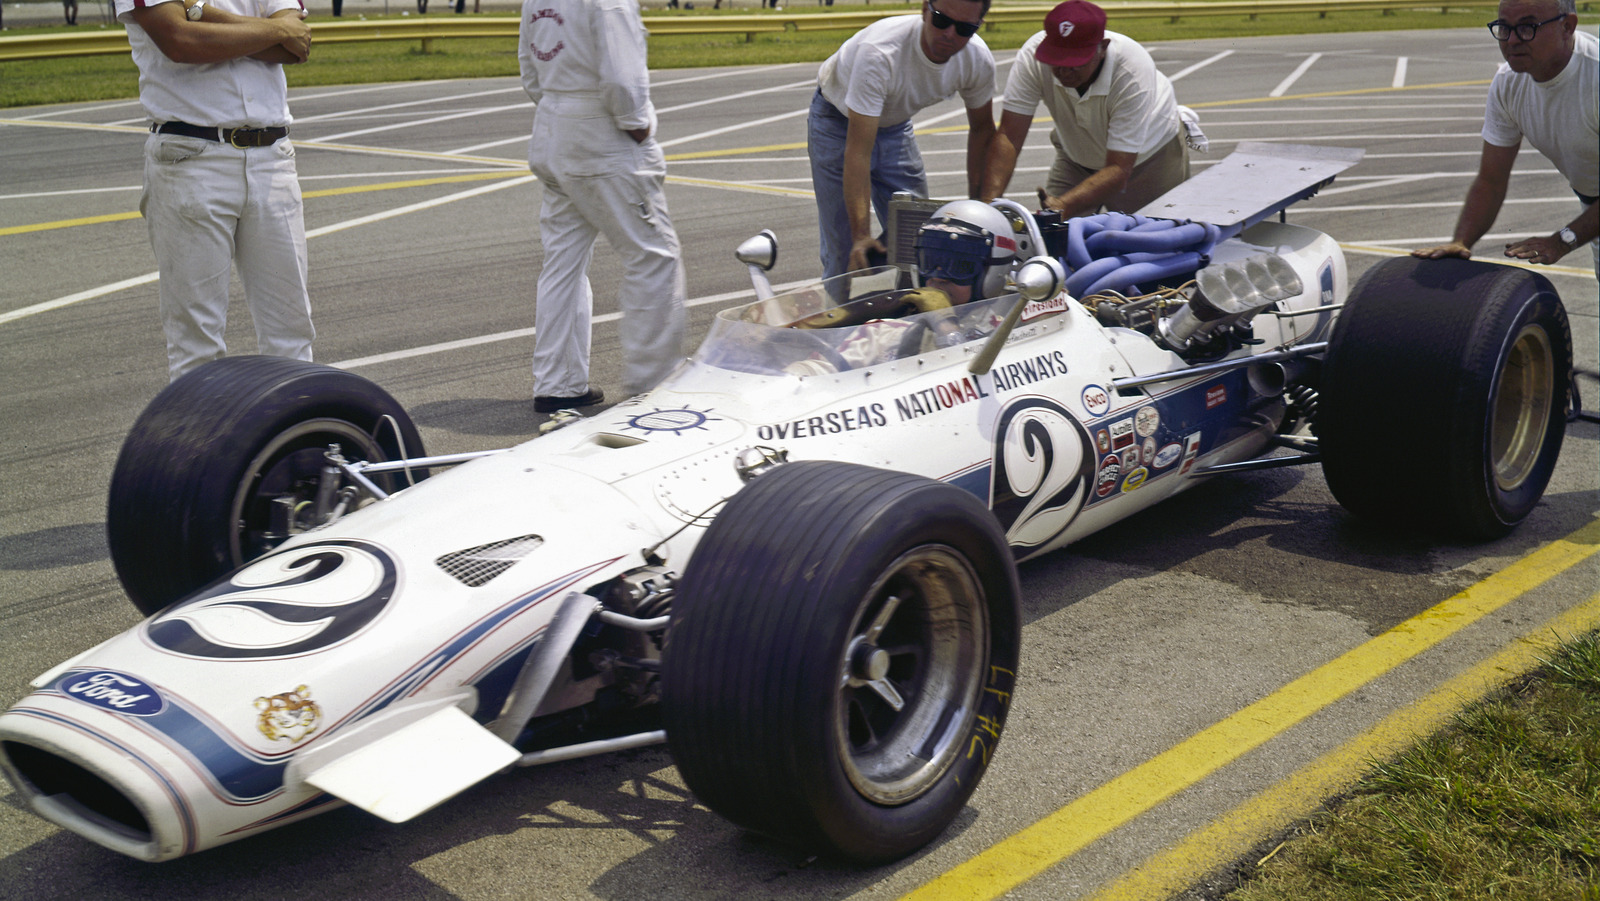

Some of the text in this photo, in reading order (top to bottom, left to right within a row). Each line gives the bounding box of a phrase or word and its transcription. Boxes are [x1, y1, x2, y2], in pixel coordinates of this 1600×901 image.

[757, 350, 1068, 440] OVERSEAS NATIONAL AIRWAYS
[1003, 405, 1085, 547] 2
[150, 545, 386, 650] 2
[68, 673, 151, 708] Ford
